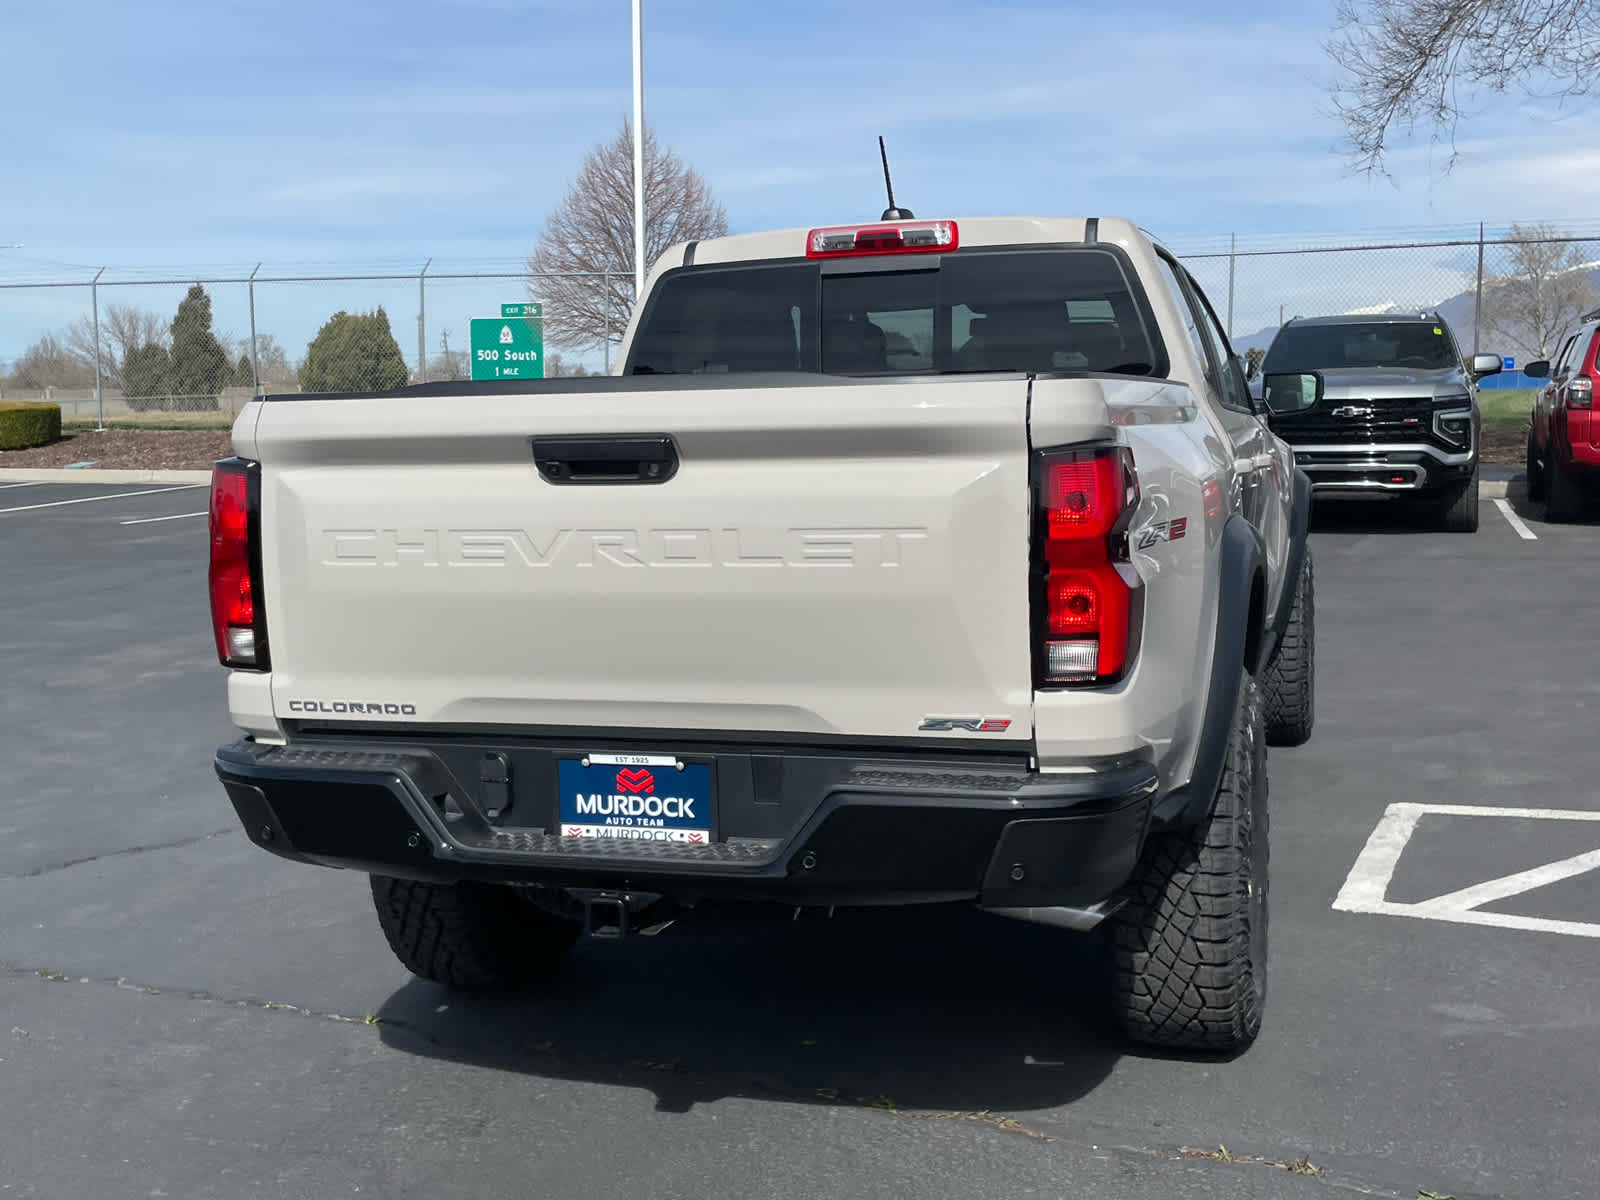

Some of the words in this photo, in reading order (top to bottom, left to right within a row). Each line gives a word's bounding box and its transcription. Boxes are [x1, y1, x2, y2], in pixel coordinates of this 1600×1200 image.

[477, 349, 499, 361] 500
[504, 349, 537, 361] South
[495, 366, 500, 377] 1
[503, 367, 519, 375] MILE
[1138, 517, 1187, 550] ZR2
[322, 527, 928, 568] CHEVROLET
[289, 700, 417, 716] COLORADO
[918, 717, 1012, 732] ZR2
[576, 793, 696, 818] MURDOCK
[605, 816, 633, 826] AUTO
[637, 817, 665, 827] TEAM
[596, 827, 676, 842] MURDOCK
